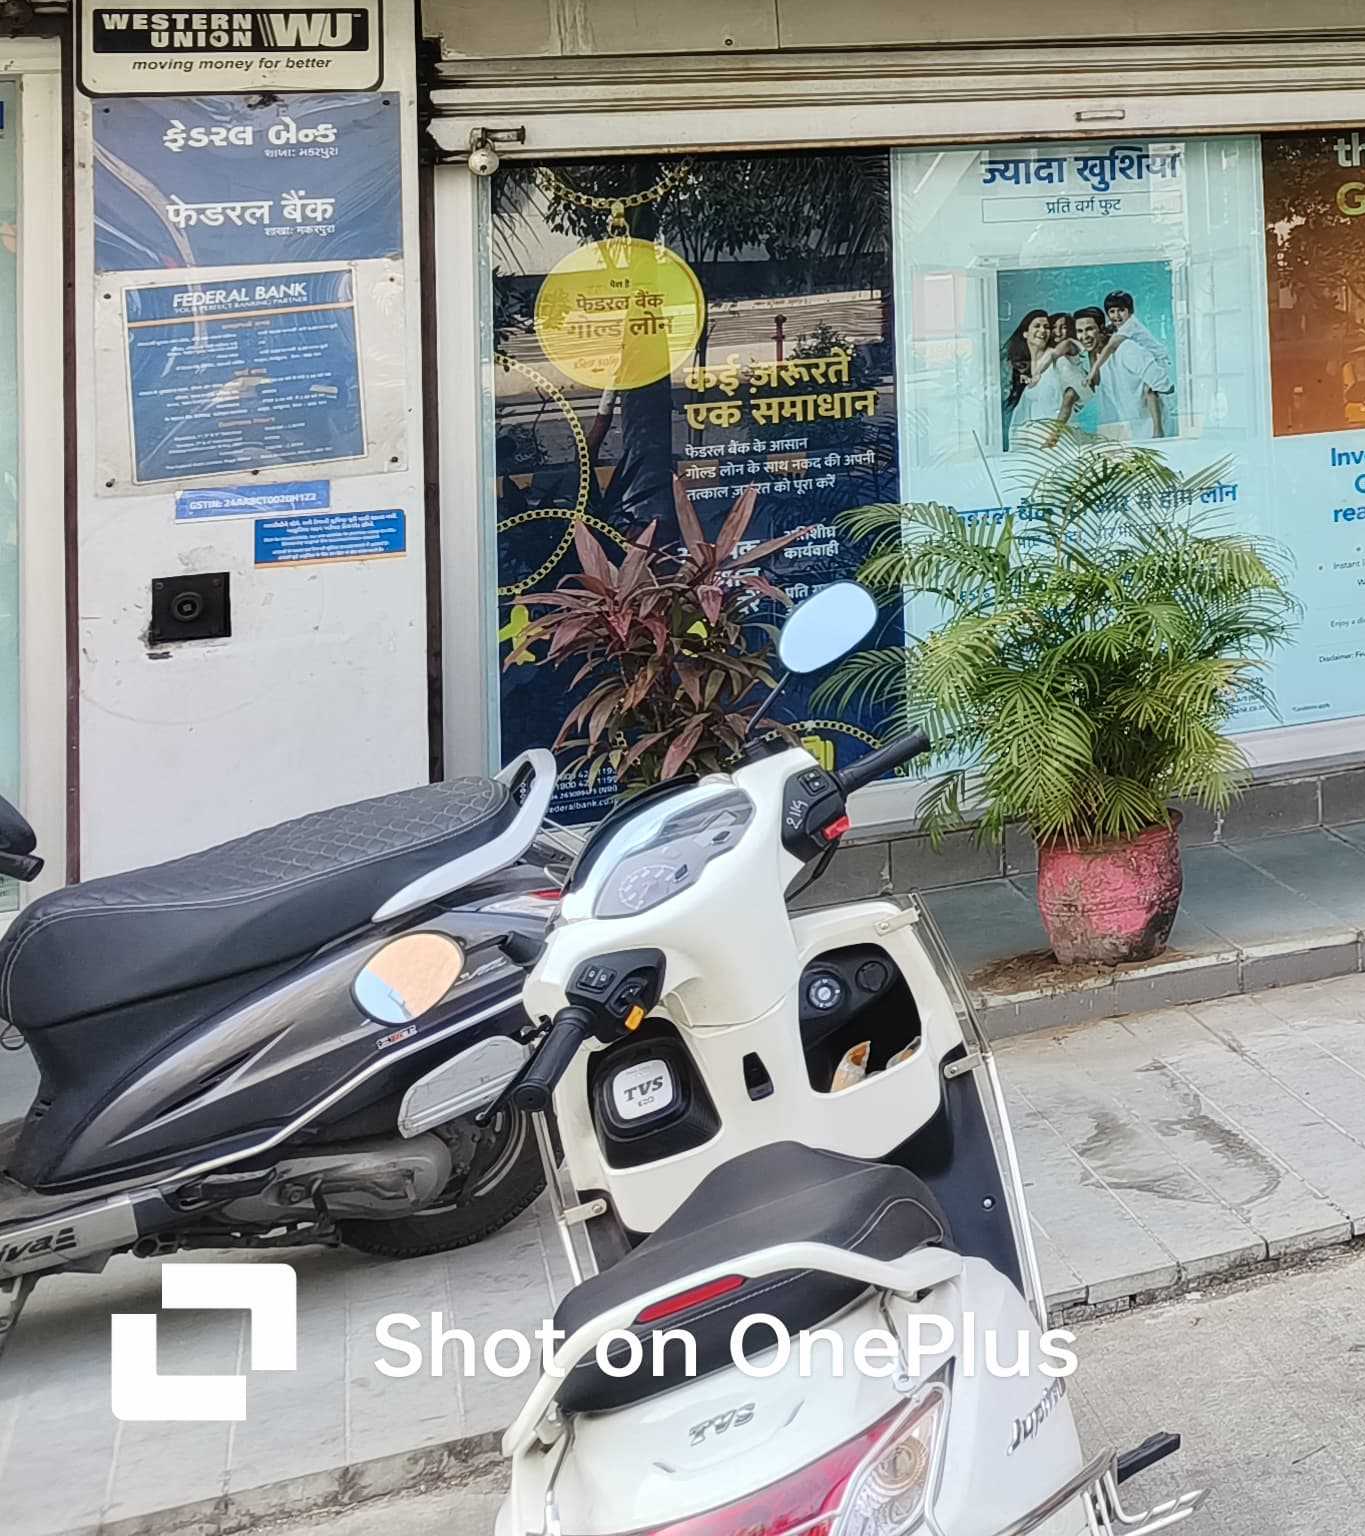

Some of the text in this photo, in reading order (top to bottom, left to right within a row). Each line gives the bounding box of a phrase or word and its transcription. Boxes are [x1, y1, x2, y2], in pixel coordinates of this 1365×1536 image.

[102, 13, 254, 31] WESTERN
[150, 13, 354, 48] UNION WU
[131, 55, 333, 73] moving money for better
[162, 115, 338, 152] ફેડરલ બેન્ક
[166, 189, 336, 229] फेडरल बैंक
[172, 282, 308, 308] FEDERAL BANK
[576, 288, 666, 314] फेडरल बैंक
[627, 311, 675, 336] लोन
[684, 353, 740, 397] कई
[684, 386, 879, 431] एक समाधान
[685, 437, 809, 459] फेडरल बैंक के आसान
[783, 539, 840, 560] कार्यवाही
[623, 1075, 665, 1102] TVS
[688, 1403, 756, 1447] TVS
